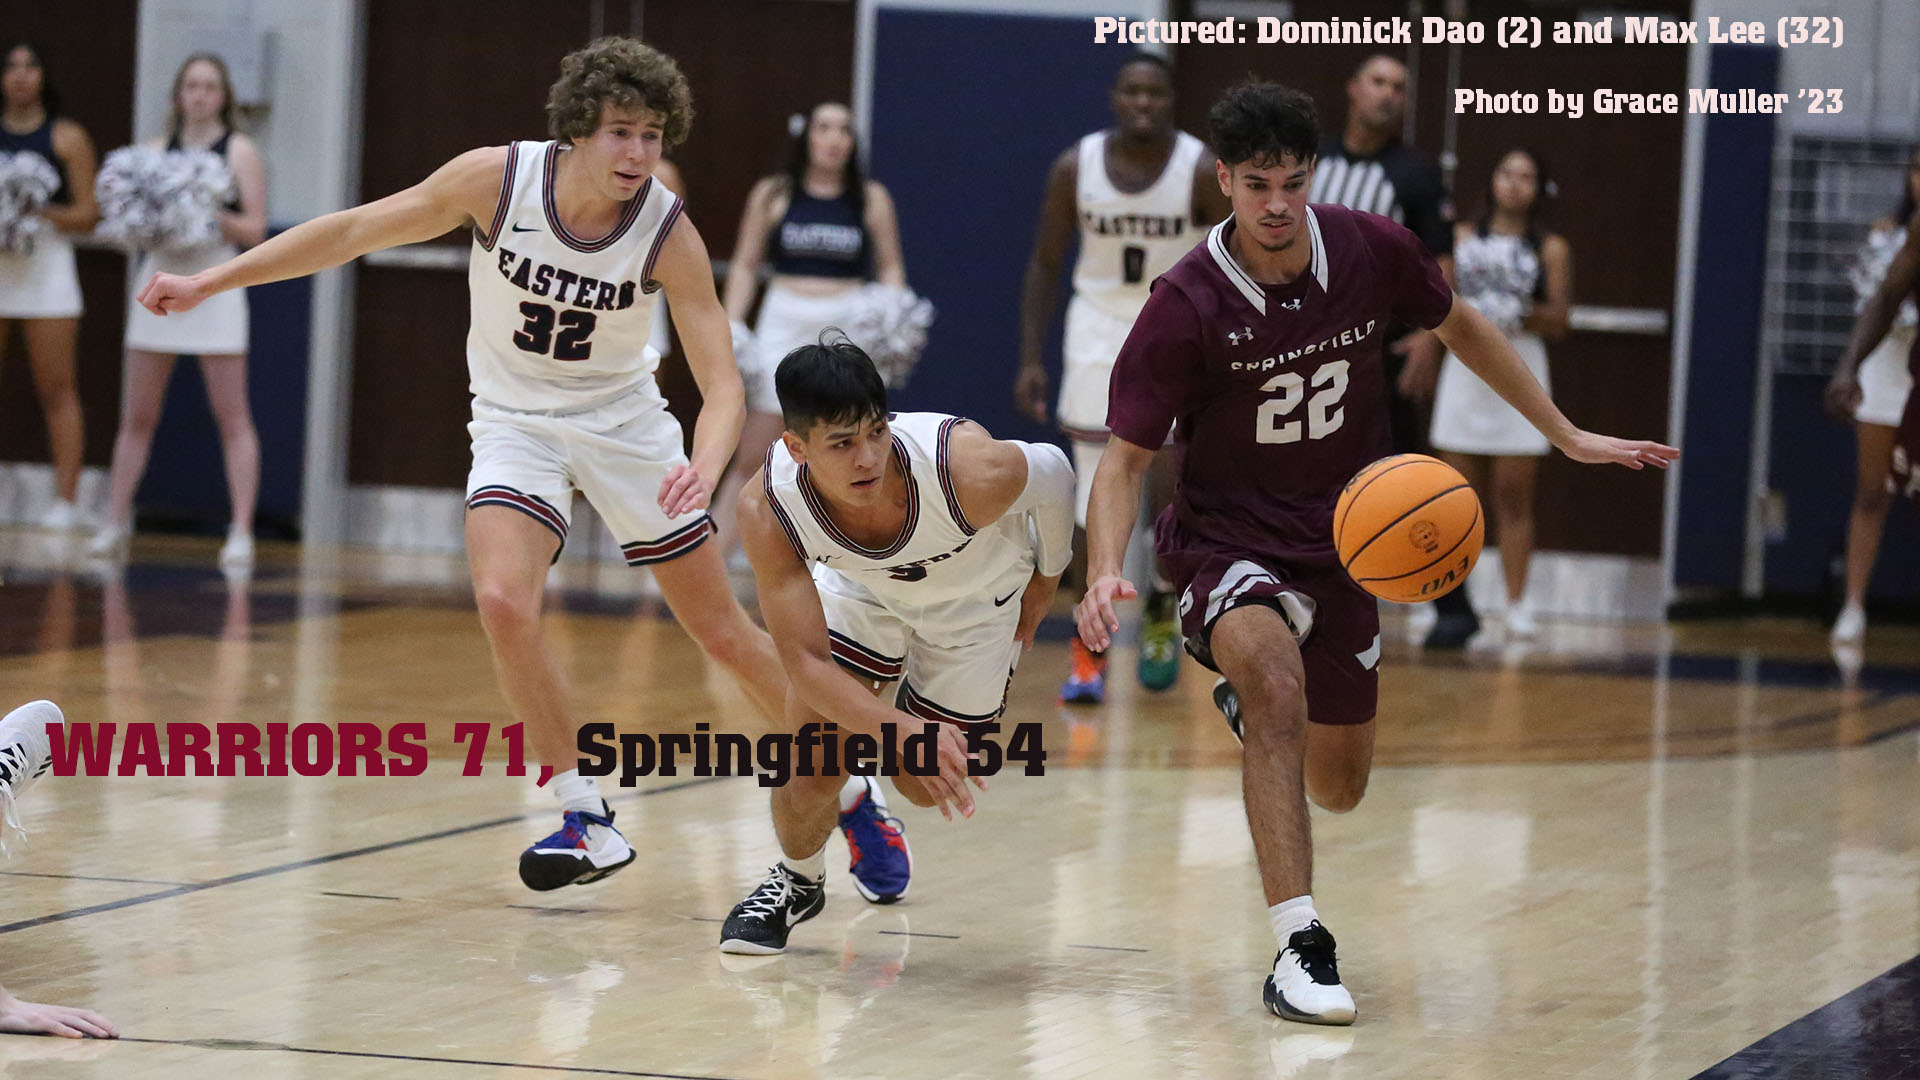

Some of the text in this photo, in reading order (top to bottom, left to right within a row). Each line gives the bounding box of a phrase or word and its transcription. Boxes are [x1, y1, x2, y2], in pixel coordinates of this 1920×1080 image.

[1123, 246, 1146, 284] 0
[512, 300, 598, 362] 32
[1256, 359, 1351, 444] 22
